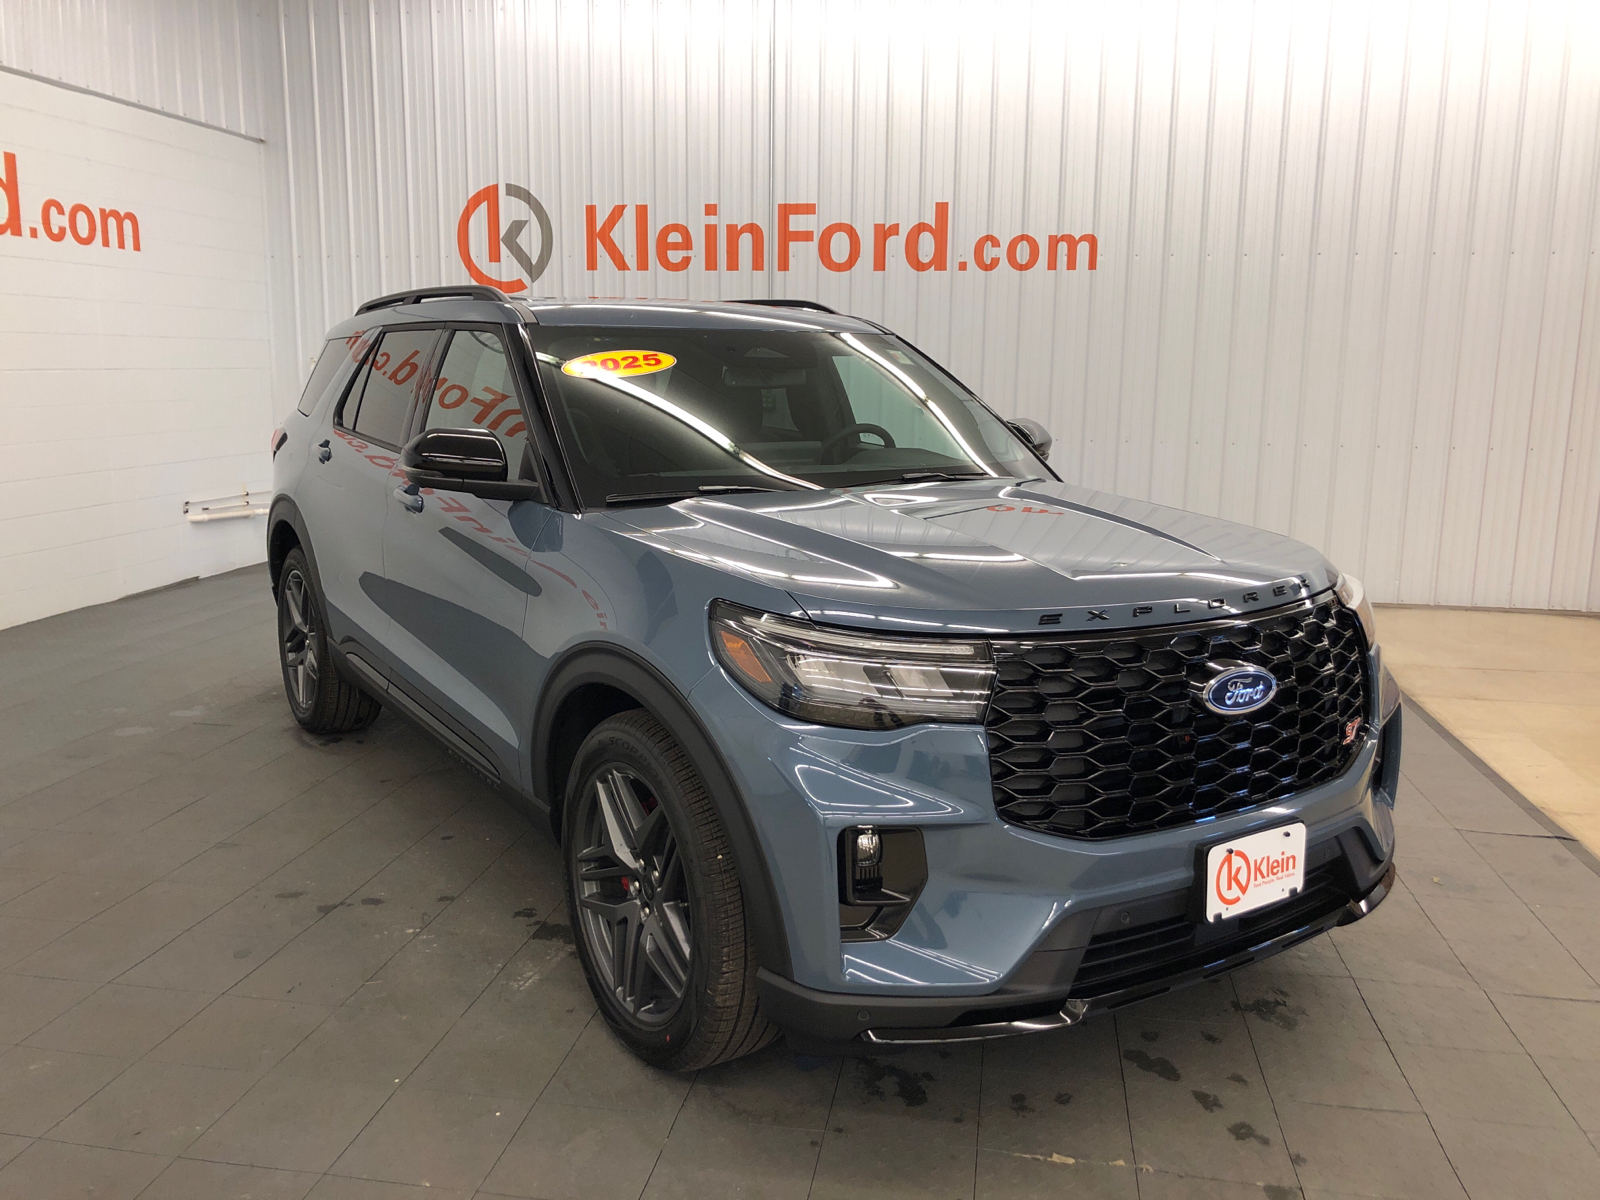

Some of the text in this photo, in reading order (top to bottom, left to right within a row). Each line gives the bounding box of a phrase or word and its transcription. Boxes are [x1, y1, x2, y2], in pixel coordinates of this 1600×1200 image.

[585, 201, 1098, 272] KleinFord.com
[1038, 578, 1311, 626] EXPLORER
[1225, 677, 1265, 705] Ford
[1253, 851, 1296, 882] Klein
